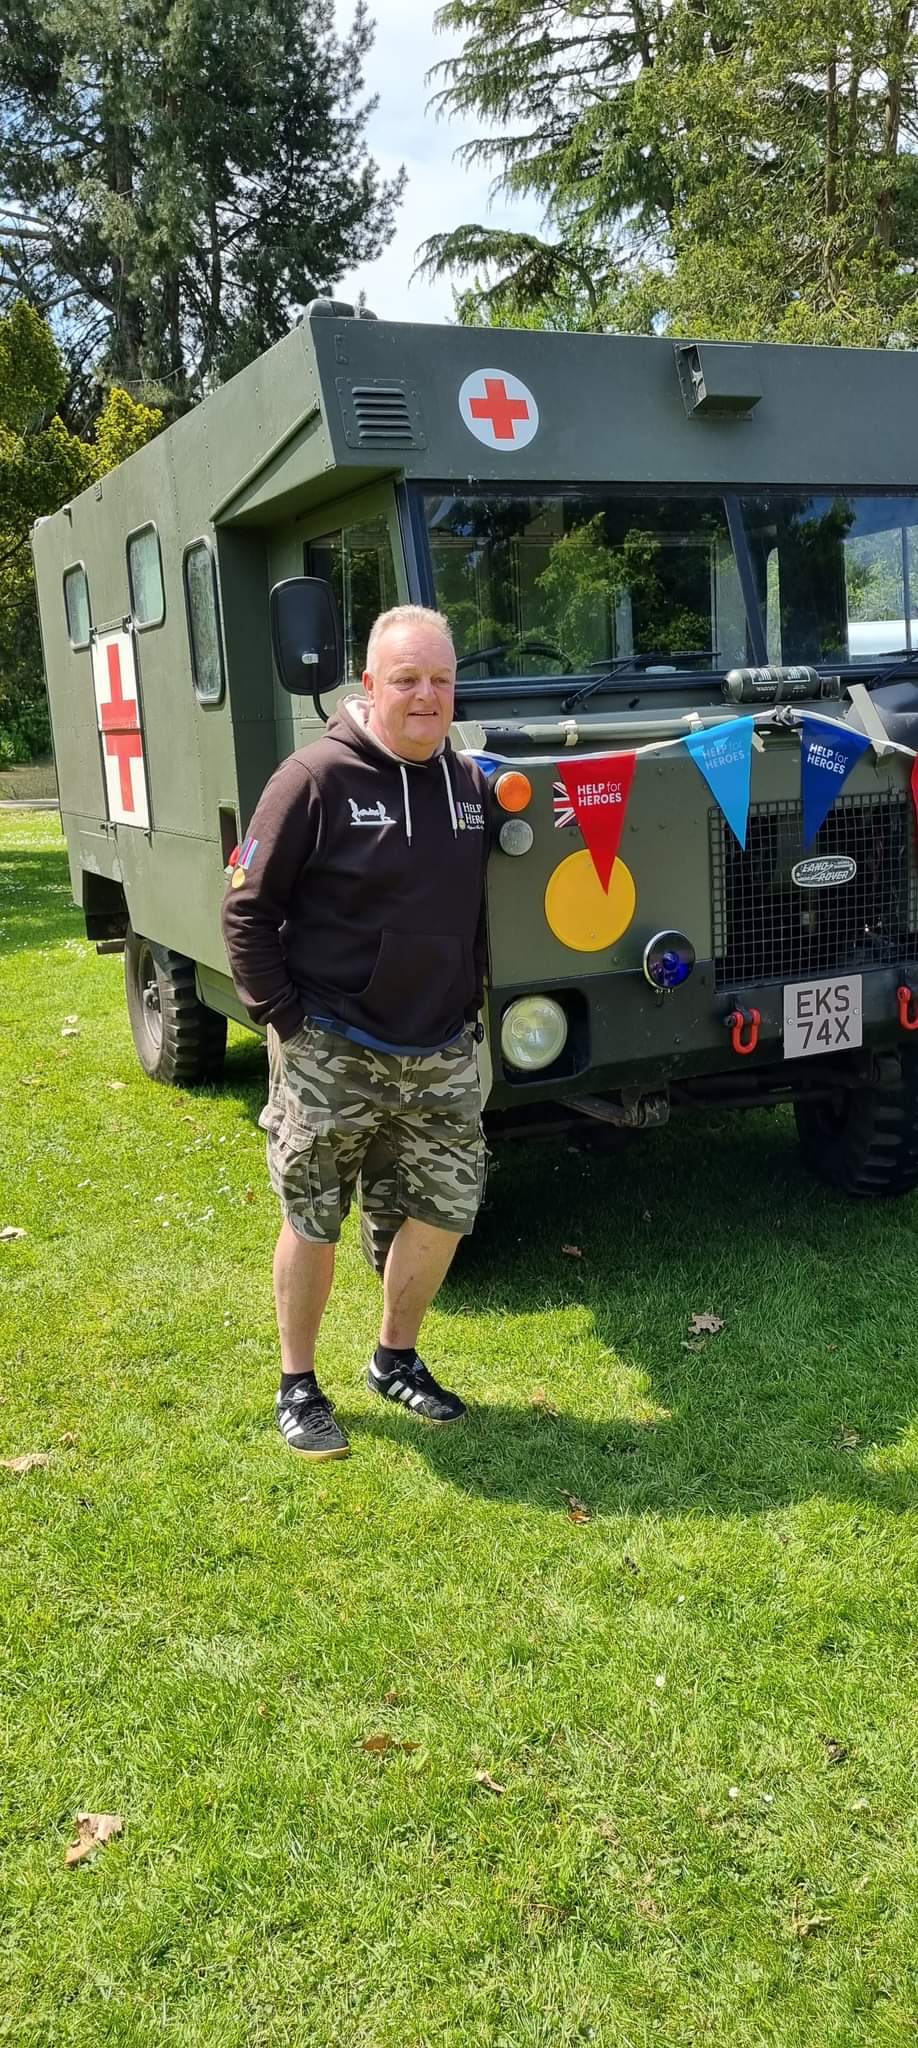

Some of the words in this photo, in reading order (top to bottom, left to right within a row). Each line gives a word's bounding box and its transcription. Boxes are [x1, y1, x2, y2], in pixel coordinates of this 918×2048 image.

[702, 745, 728, 760] HELP
[728, 740, 743, 753] for
[705, 750, 745, 769] HEROES
[809, 743, 833, 759] HELP
[834, 751, 849, 764] for
[807, 753, 846, 774] HEROES
[577, 783, 605, 795] HELP
[606, 781, 622, 793] for
[462, 801, 482, 813] HELP
[578, 792, 622, 806] HEROES
[801, 862, 828, 873] LAND
[818, 870, 849, 882] ROVER
[797, 984, 850, 1018] EKS
[797, 1015, 850, 1049] 74X
